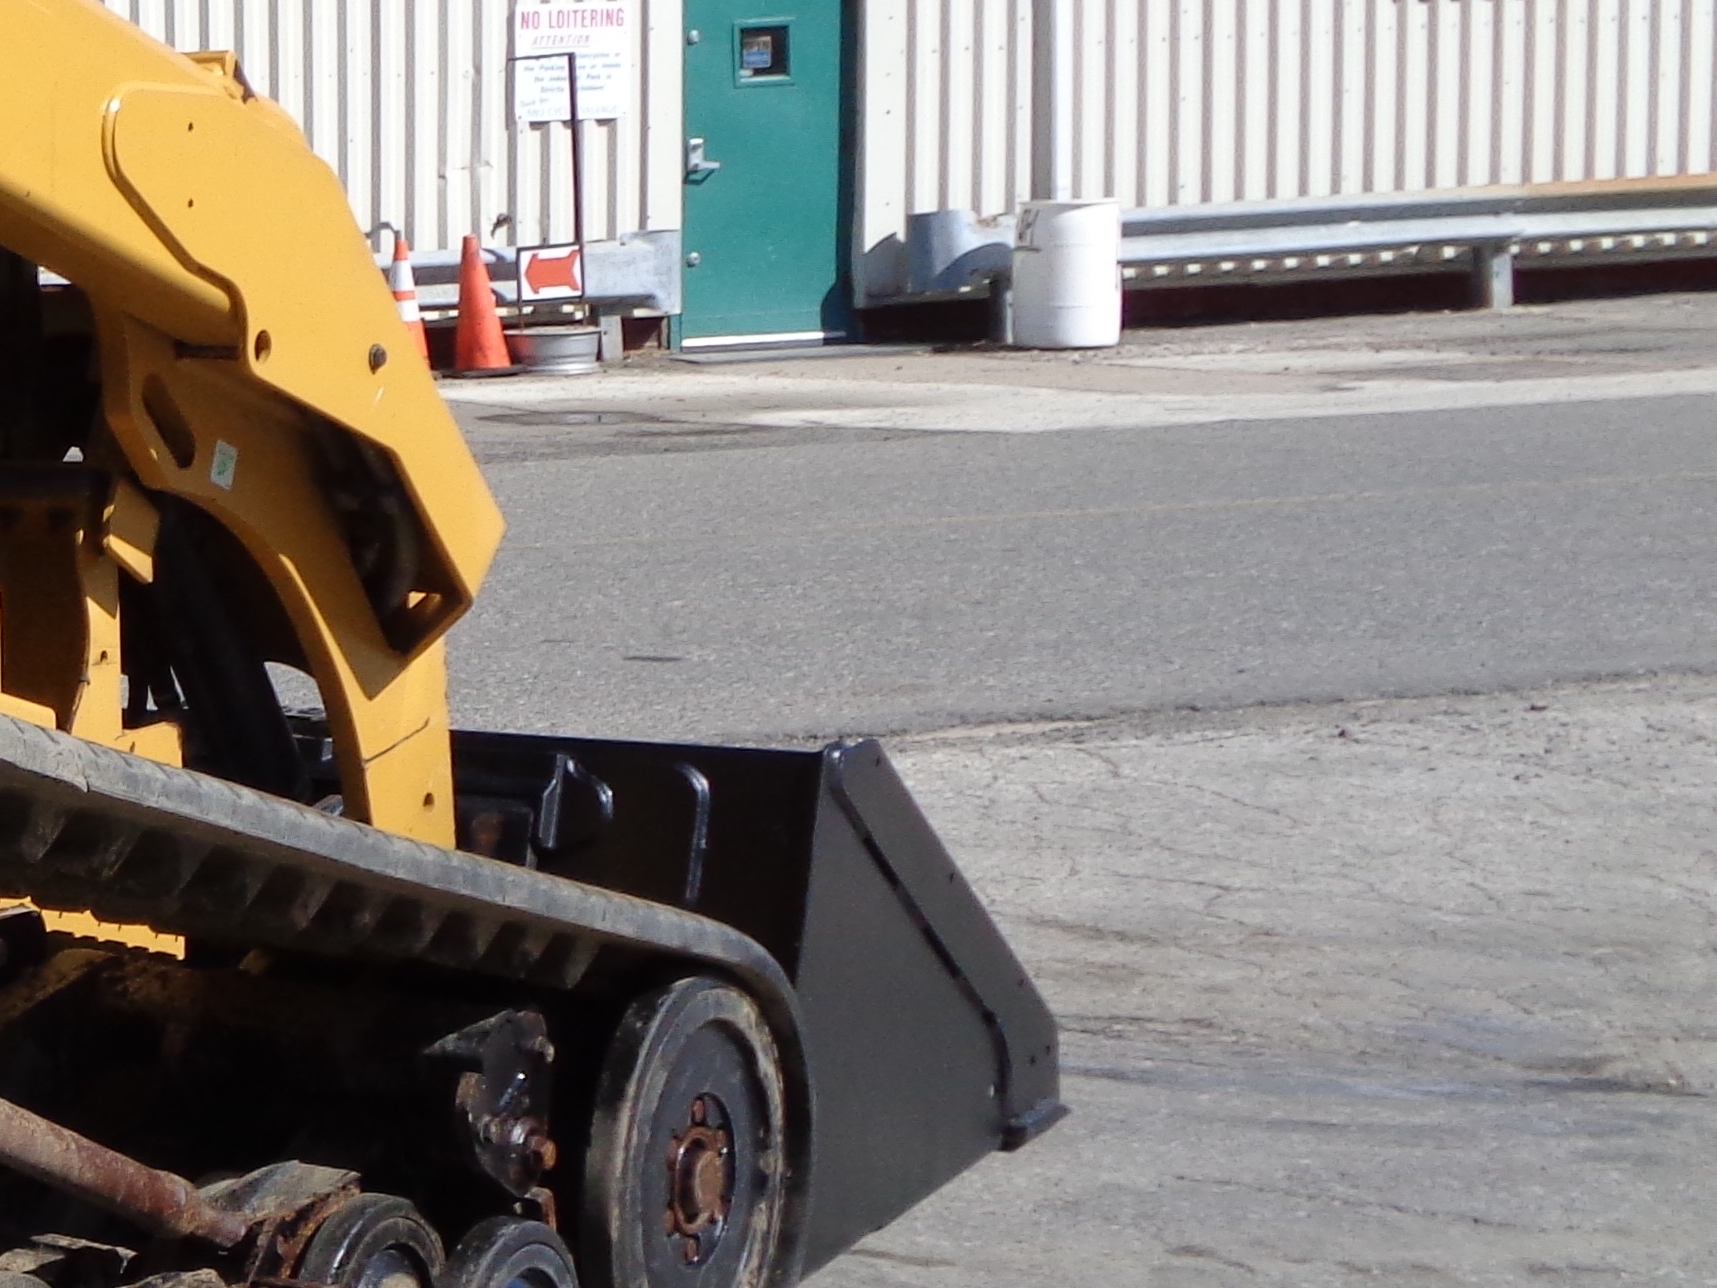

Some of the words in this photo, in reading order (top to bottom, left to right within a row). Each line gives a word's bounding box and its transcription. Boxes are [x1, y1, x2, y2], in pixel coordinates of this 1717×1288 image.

[520, 10, 540, 30] NO
[549, 8, 625, 29] LOITERING
[531, 34, 590, 46] ATTENTION
